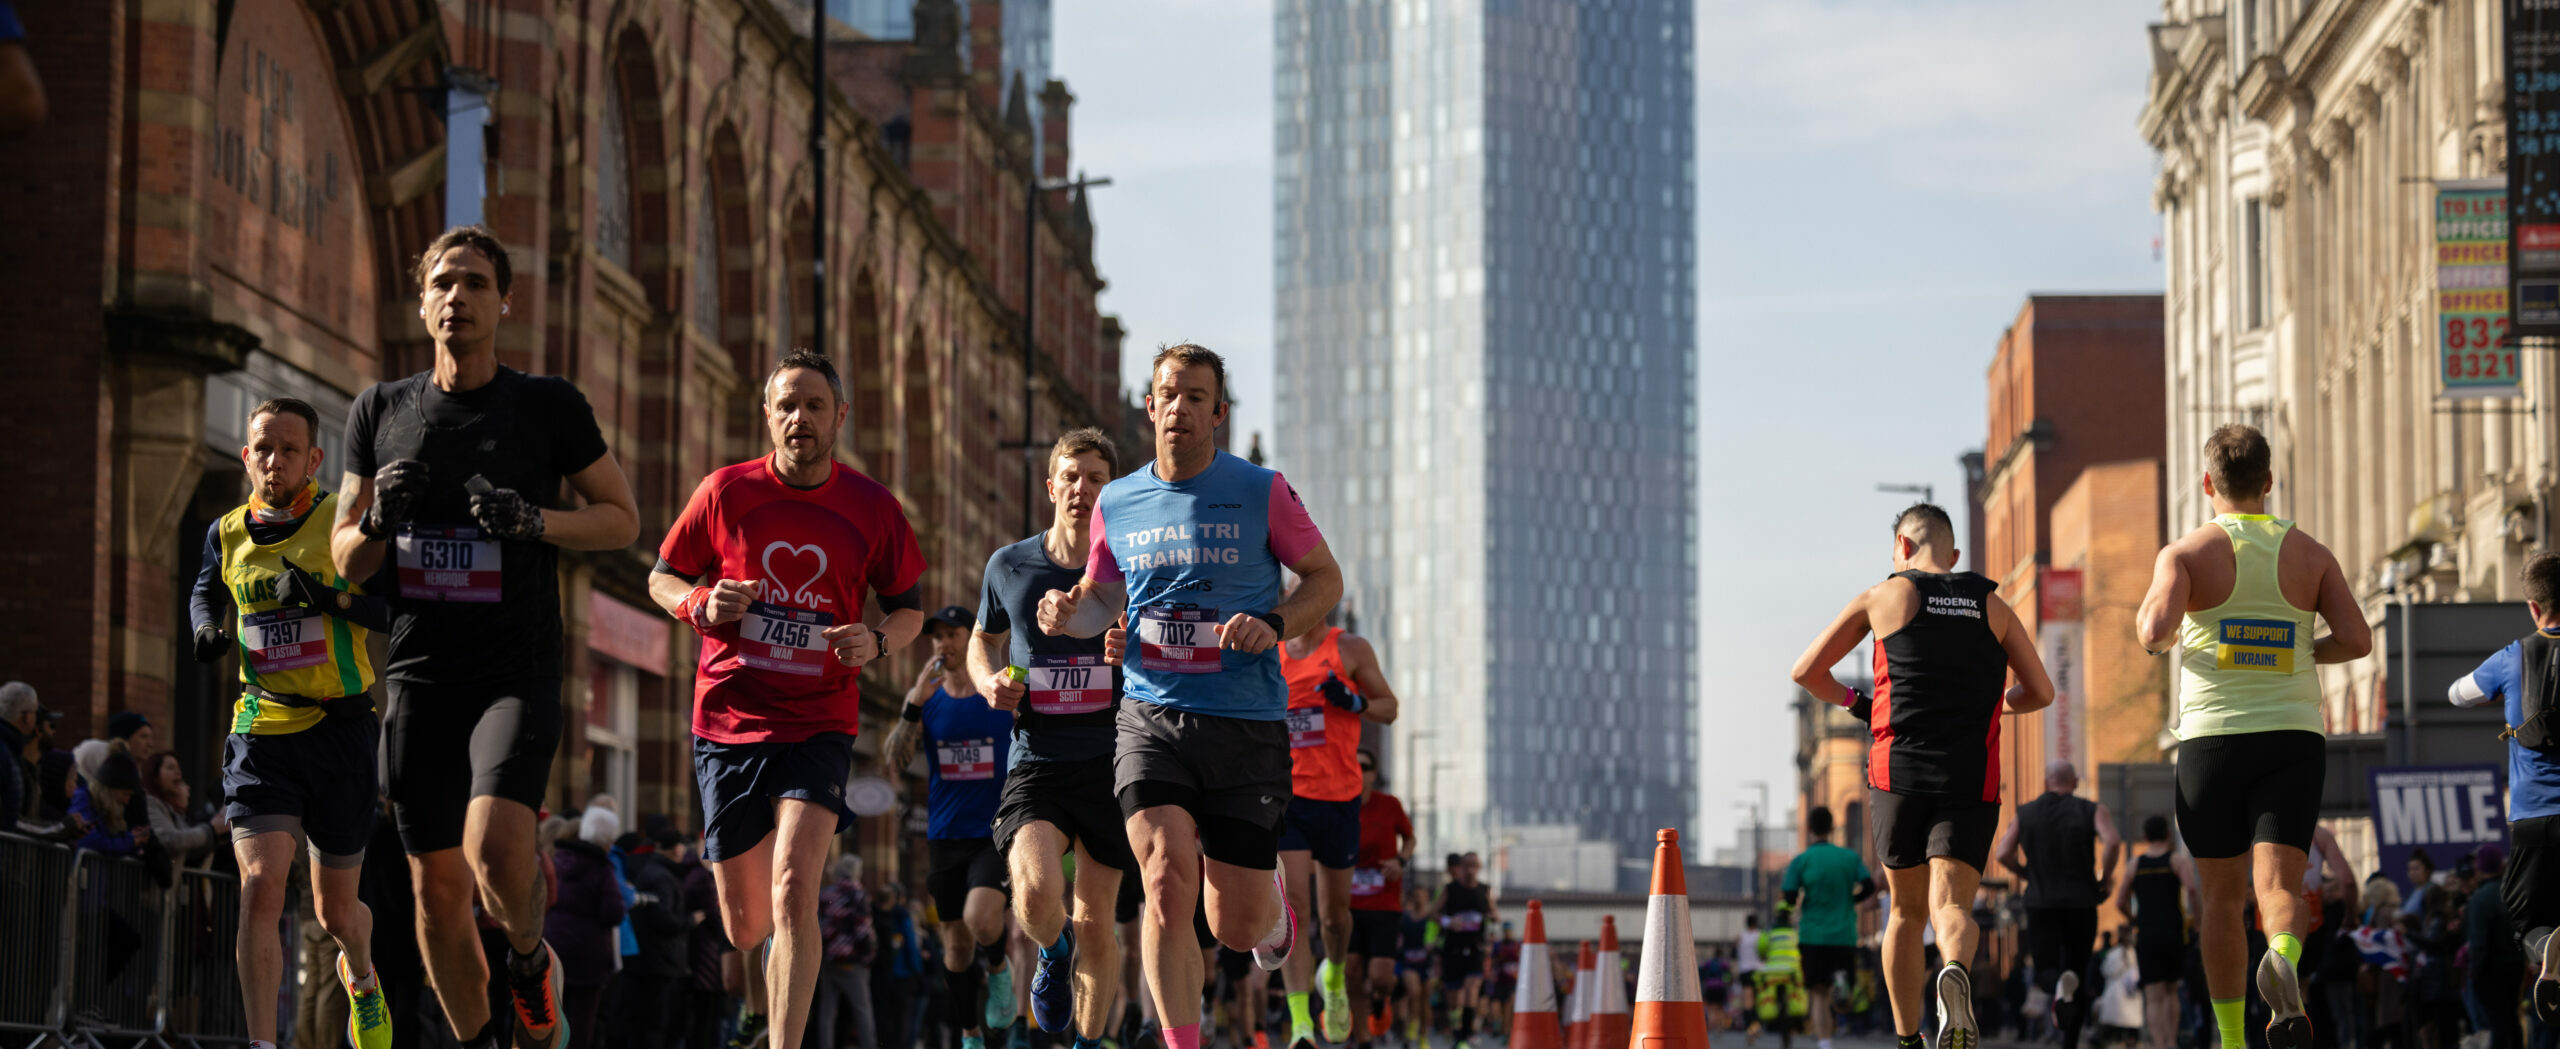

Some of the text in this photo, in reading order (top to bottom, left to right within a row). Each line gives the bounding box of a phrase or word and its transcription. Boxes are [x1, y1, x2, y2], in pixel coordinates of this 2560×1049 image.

[2443, 198, 2508, 216] TO LET
[2438, 219, 2508, 238] OFFICE
[2446, 317, 2510, 349] 832
[2447, 353, 2515, 378] 8321
[1126, 523, 1240, 548] TOTAL TRI
[421, 541, 473, 570] 6310
[1126, 547, 1240, 573] TRAINING
[424, 571, 471, 588] HENRIQUE
[1928, 596, 1978, 608] PHOENIX
[1926, 606, 1981, 619] ROAD RUNNERS
[259, 620, 302, 648] 7397
[760, 618, 811, 648] 7456
[1156, 621, 1196, 646] 7012
[2226, 624, 2289, 642] WE SUPPORT
[267, 645, 302, 661] ALASTAIR
[769, 645, 794, 661] IWAN
[1160, 646, 1194, 660] WRIGHTY
[2234, 651, 2278, 667] UKRAINE
[1049, 667, 1092, 690] 7707
[1059, 691, 1083, 703] SCOTT
[950, 748, 980, 763] 7049
[2377, 785, 2502, 845] MILE
